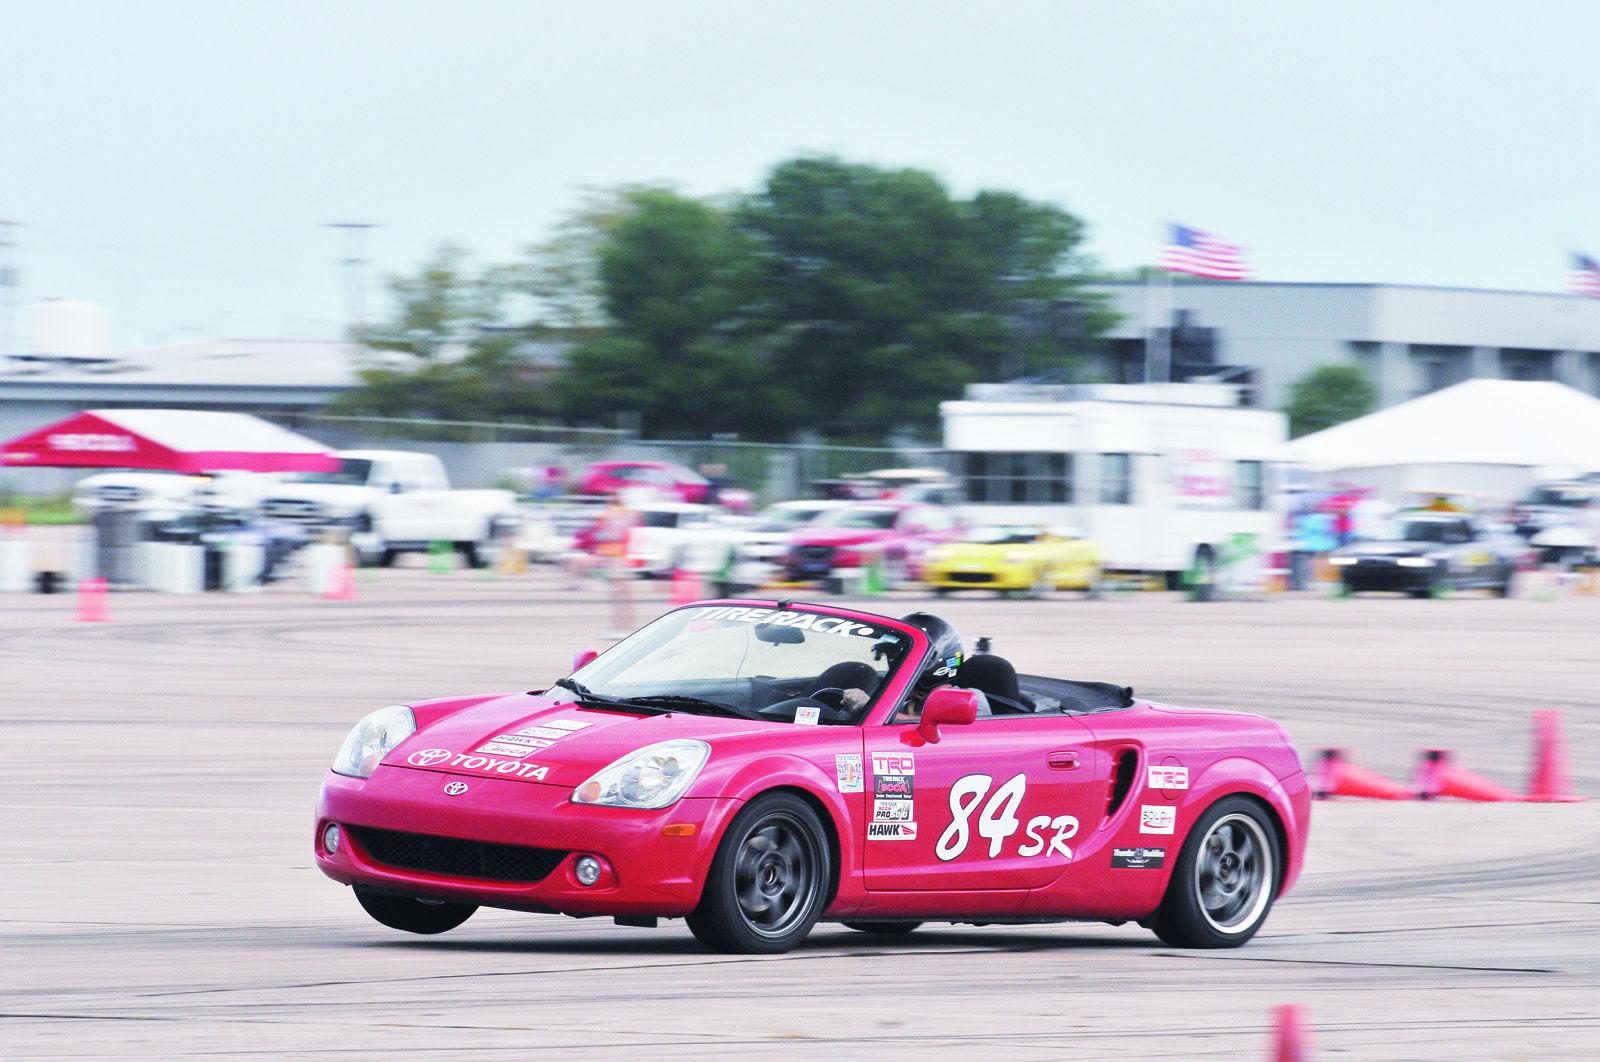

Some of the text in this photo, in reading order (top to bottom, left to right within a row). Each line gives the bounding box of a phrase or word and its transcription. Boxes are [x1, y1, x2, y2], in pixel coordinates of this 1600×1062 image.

[688, 606, 867, 637] TIRE RACK
[450, 753, 550, 781] TOYOTA
[874, 757, 913, 774] TRD
[881, 783, 907, 793] SCCA
[1152, 770, 1186, 788] TRD
[935, 772, 1080, 861] 84 SR
[869, 825, 900, 835] HAWK
